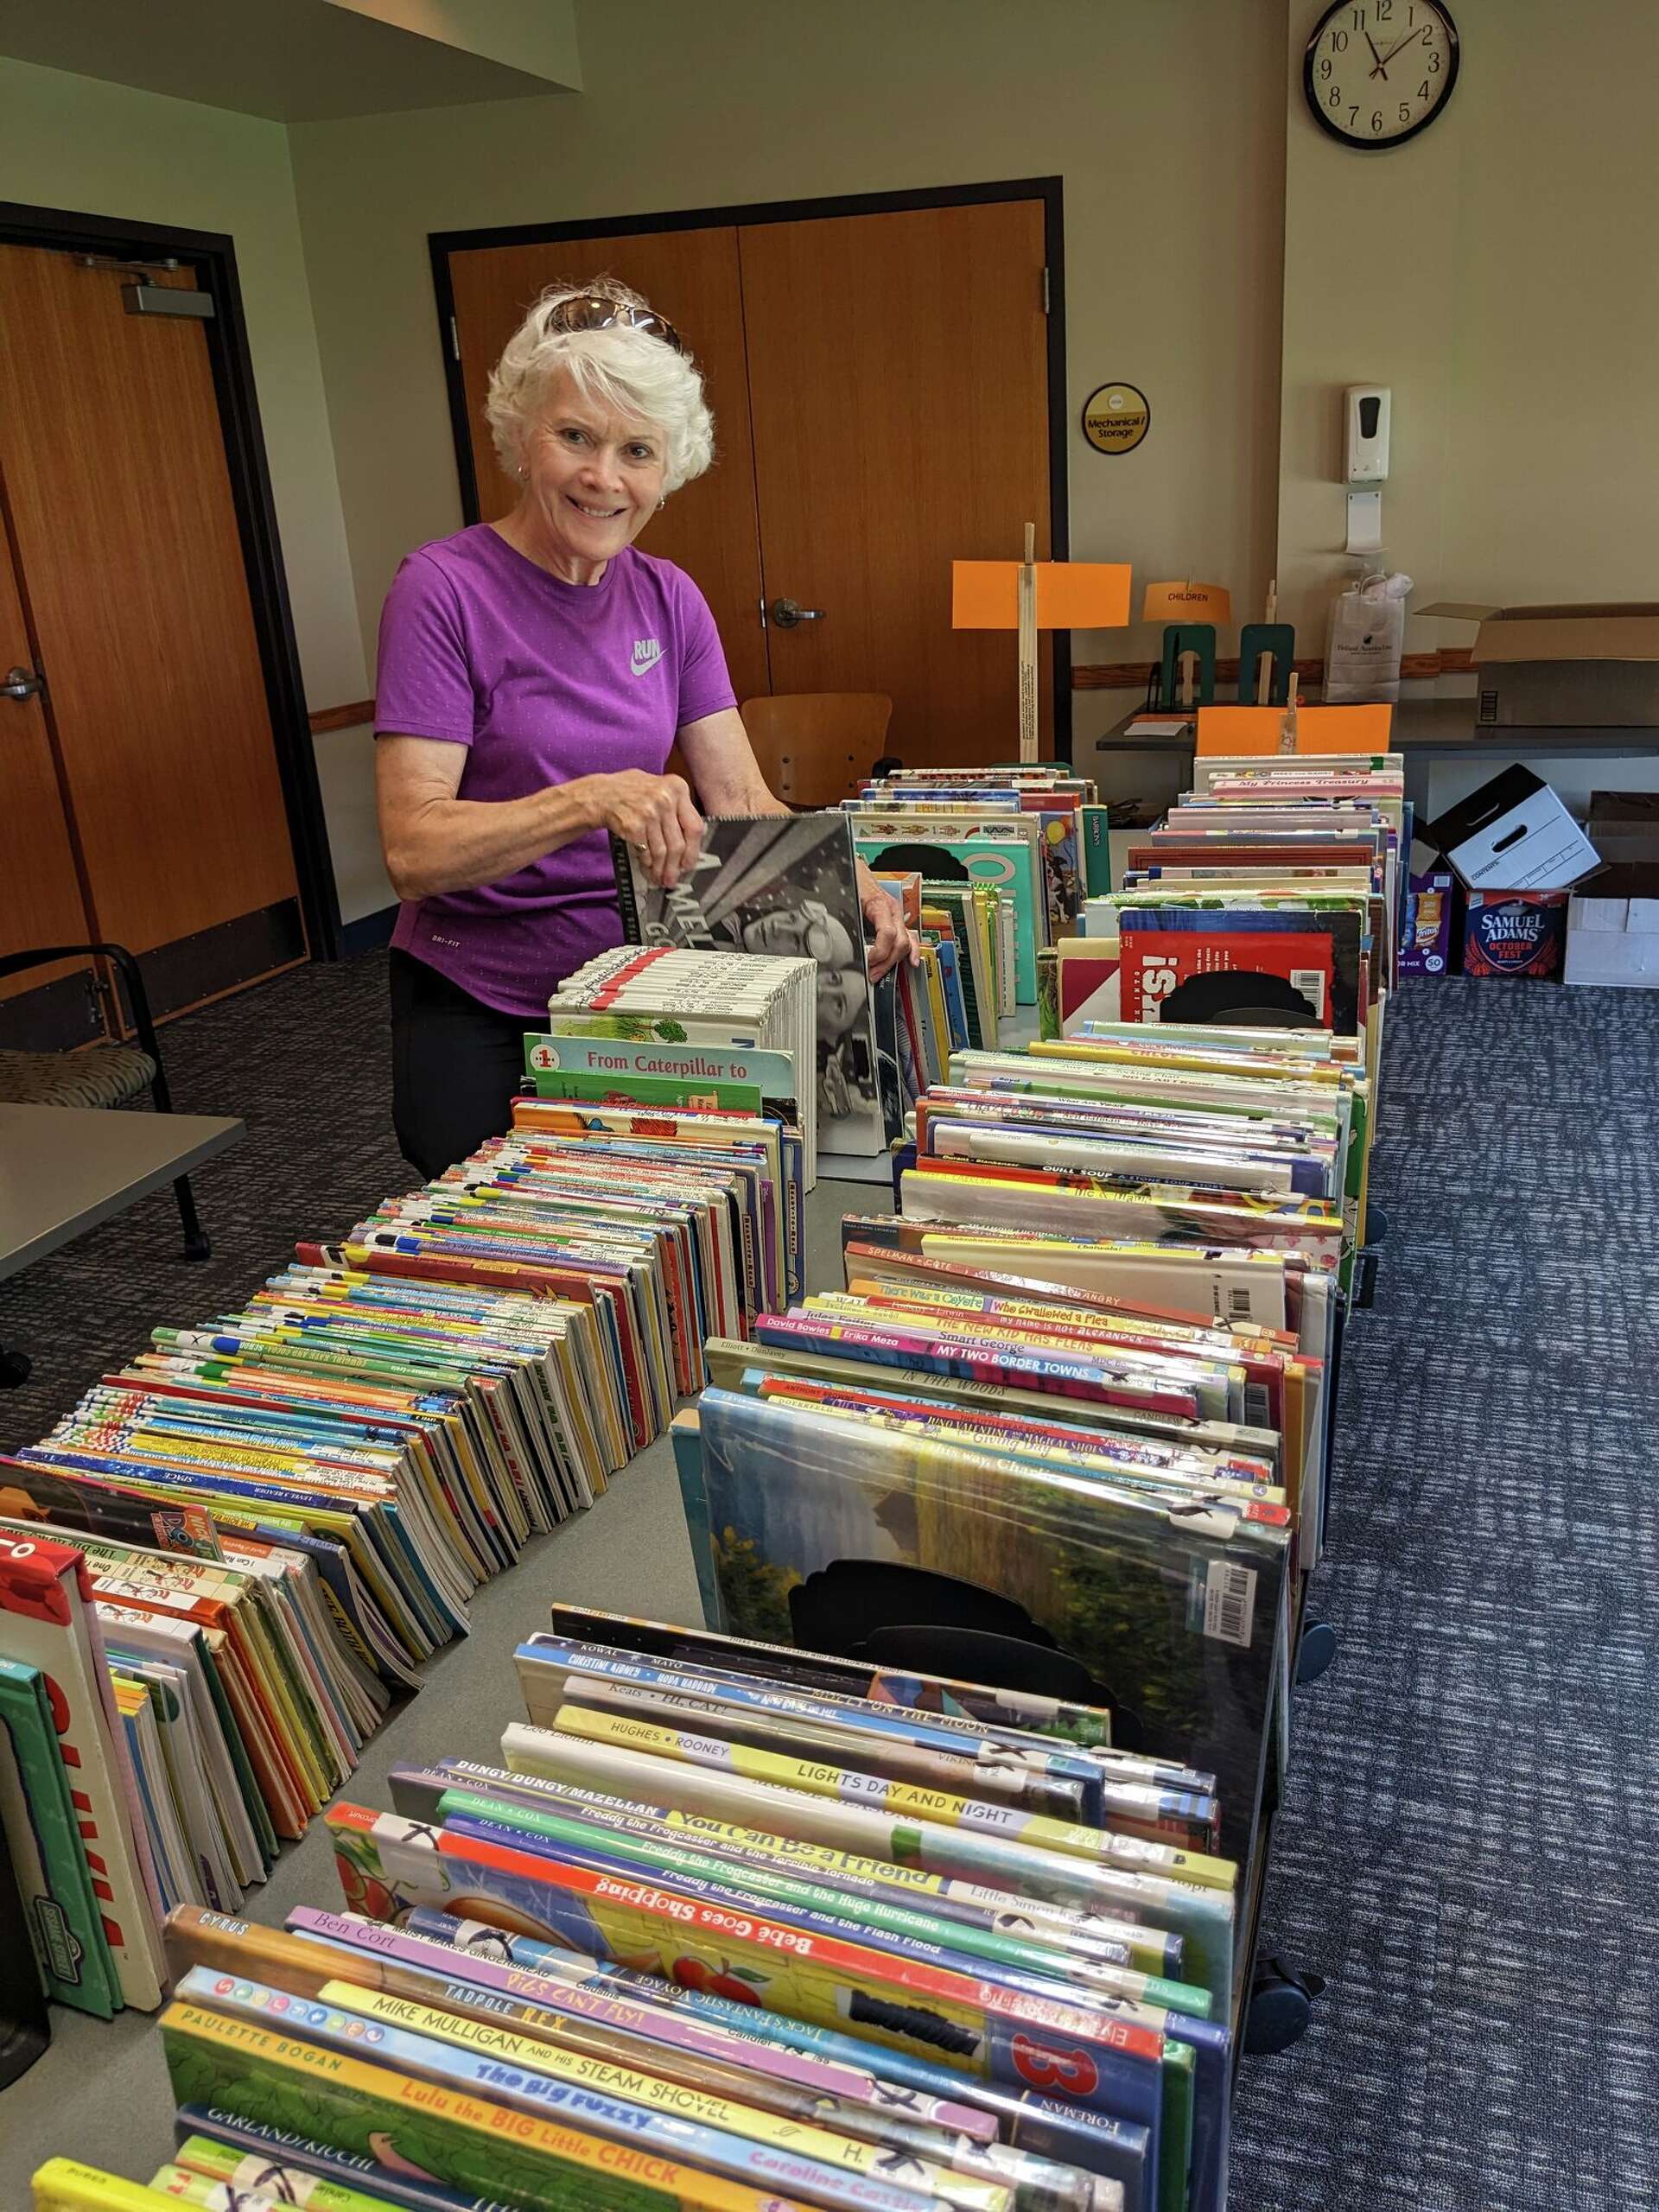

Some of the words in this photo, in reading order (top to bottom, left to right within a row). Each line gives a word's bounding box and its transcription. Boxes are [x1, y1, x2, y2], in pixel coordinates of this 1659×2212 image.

[1352, 10, 1364, 31] 11
[1376, 0, 1392, 21] 12
[1409, 6, 1414, 27] 1
[1332, 31, 1348, 52] 10
[1422, 25, 1433, 46] 2
[1321, 59, 1332, 80] 9
[1428, 53, 1440, 73] 3
[1330, 86, 1340, 106] 8
[1418, 80, 1429, 101] 4
[1349, 106, 1359, 126] 7
[1371, 111, 1382, 131] 6
[1399, 103, 1410, 121] 5
[1099, 429, 1134, 438] Storage
[1168, 593, 1208, 601] CHILDREN
[634, 639, 660, 659] RUN
[1316, 776, 1370, 786] Treasury
[1481, 914, 1545, 929] SAMUEL
[1485, 929, 1538, 942] ADAMS
[587, 1051, 630, 1071] From
[634, 1052, 725, 1078] Caterpillar
[728, 1063, 747, 1078] to
[1042, 1166, 1075, 1175] QUILL
[1081, 1168, 1113, 1179] SOUP
[868, 1247, 913, 1262] SPELMAN
[943, 1294, 982, 1311] Coyote
[993, 1300, 1017, 1313] Who
[1084, 1313, 1109, 1326] Flea
[936, 1319, 961, 1330] THE
[964, 1321, 995, 1336] NEW
[997, 1325, 1020, 1339] KID
[1024, 1332, 1052, 1345] HAS
[1055, 1337, 1095, 1352] FLEAS
[1055, 1324, 1075, 1334] not
[766, 1318, 794, 1329] David
[797, 1322, 830, 1336] Bowles
[842, 1329, 868, 1342] Erika
[870, 1334, 899, 1347] Meza
[937, 1344, 957, 1357] MY
[960, 1348, 988, 1362] TWO
[991, 1352, 1040, 1372] BORDER
[1043, 1360, 1090, 1378] TOWNS
[938, 1330, 977, 1344] Smart
[980, 1337, 1026, 1354] George
[785, 1383, 823, 1396] ANTHONY
[901, 1370, 915, 1382] IN
[923, 1374, 952, 1388] THE
[956, 1379, 1009, 1396] WOODS
[927, 1416, 954, 1427] JUNO
[956, 1421, 1009, 1438] VALENTINE
[162, 1471, 194, 1484] SPACE
[254, 1485, 285, 1499] READER
[291, 1492, 314, 1503] LEVEL
[580, 1644, 619, 1657] KOWAL
[651, 1658, 683, 1669] MAYO
[870, 1700, 894, 1714] ON
[901, 1707, 931, 1722] THE
[608, 1683, 642, 1698] Keats
[610, 1722, 660, 1742] HUGHES
[675, 1736, 729, 1757] ROONEY
[796, 1764, 861, 1789] LIGHTS
[866, 1779, 906, 1798] DAY
[906, 1790, 947, 1808] AND
[951, 1801, 1013, 1823] NIGHT
[422, 1767, 454, 1782] DEAN
[465, 1780, 492, 1790] COX
[581, 1806, 624, 1828] Freddy
[626, 1817, 647, 1833] the
[649, 1823, 719, 1847] Frogcaster
[720, 1842, 744, 1854] and
[747, 1847, 767, 1860] the
[680, 1814, 721, 1833] You
[728, 1824, 775, 1847] Can
[839, 1853, 931, 1885] Friend
[479, 1819, 512, 1833] DEAN
[524, 1831, 551, 1844] COX
[661, 1869, 710, 1891] Freddy
[810, 1909, 836, 1923] and
[838, 1916, 861, 1932] the
[902, 1936, 942, 1955] Flood
[595, 1878, 694, 1921] Shopping
[701, 1910, 752, 1936] Goes
[874, 1902, 940, 1931] Hurricane
[199, 1910, 251, 1936] CYRUS
[444, 1983, 515, 2013] TADPOLE
[522, 2005, 569, 2031] REX
[314, 1912, 353, 1934] Ben
[355, 1927, 396, 1949] Cort
[552, 1988, 604, 2012] CAN'T
[607, 2002, 645, 2026] FLY!
[372, 1996, 419, 2022] MIKE
[423, 2012, 524, 2054] MULLIGAN
[526, 2044, 553, 2058] AND
[554, 2053, 574, 2066] HIS
[576, 2060, 645, 2093] STEAM
[649, 2082, 729, 2121] SHOVEL
[635, 1974, 692, 2003] VOYAGE
[1040, 2099, 1121, 2135] FOREMAN
[181, 2010, 271, 2046] PAULETTE
[276, 2042, 343, 2071] BOGAN
[400, 2081, 448, 2110] Lulu
[454, 2099, 485, 2122] the
[491, 2108, 535, 2137] BIG
[539, 2128, 591, 2158] Little
[597, 2144, 679, 2186] CHICK
[207, 2107, 376, 2171] GARLAND/KIUCHI
[749, 2150, 844, 2190] Caroline
